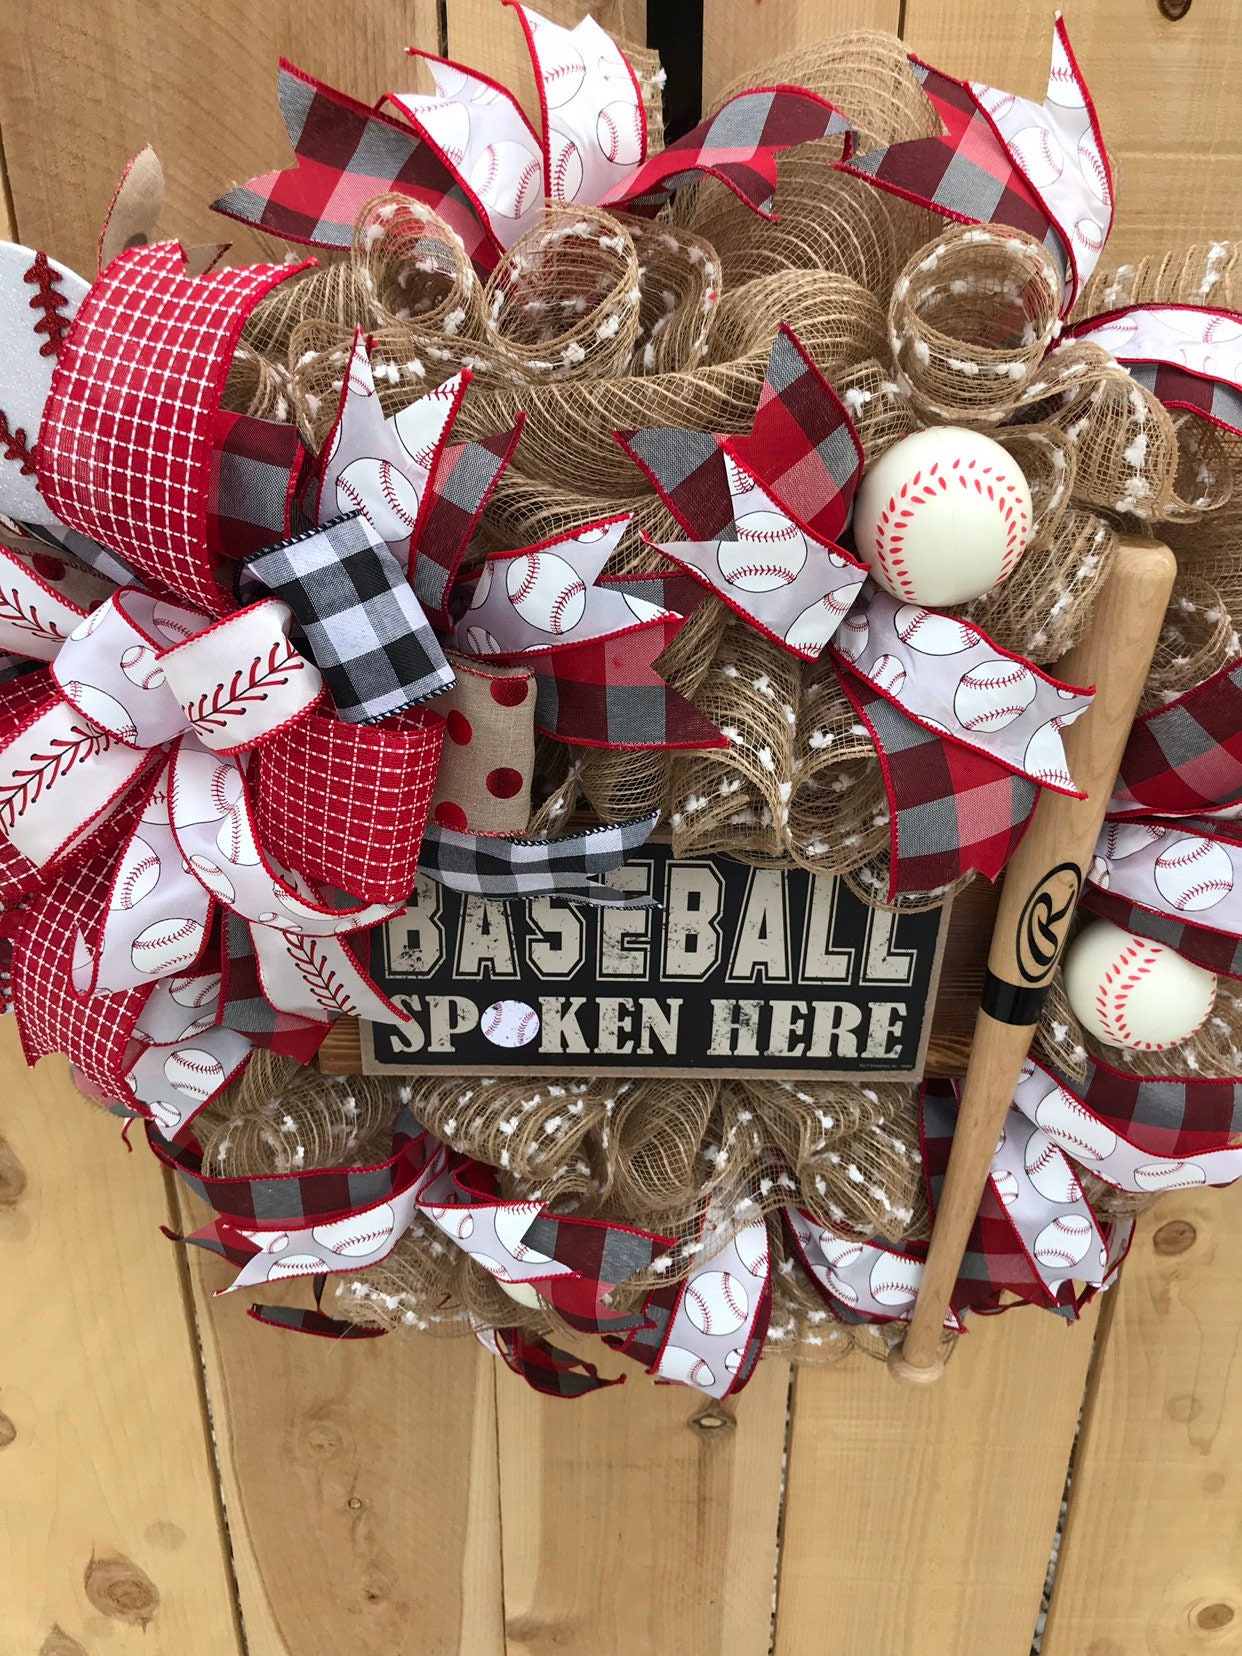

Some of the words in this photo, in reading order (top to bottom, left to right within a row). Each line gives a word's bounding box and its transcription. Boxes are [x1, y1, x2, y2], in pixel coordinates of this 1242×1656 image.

[383, 859, 917, 987] BASEBALL
[388, 994, 683, 1055] SPOKEN
[706, 998, 908, 1059] HERE
